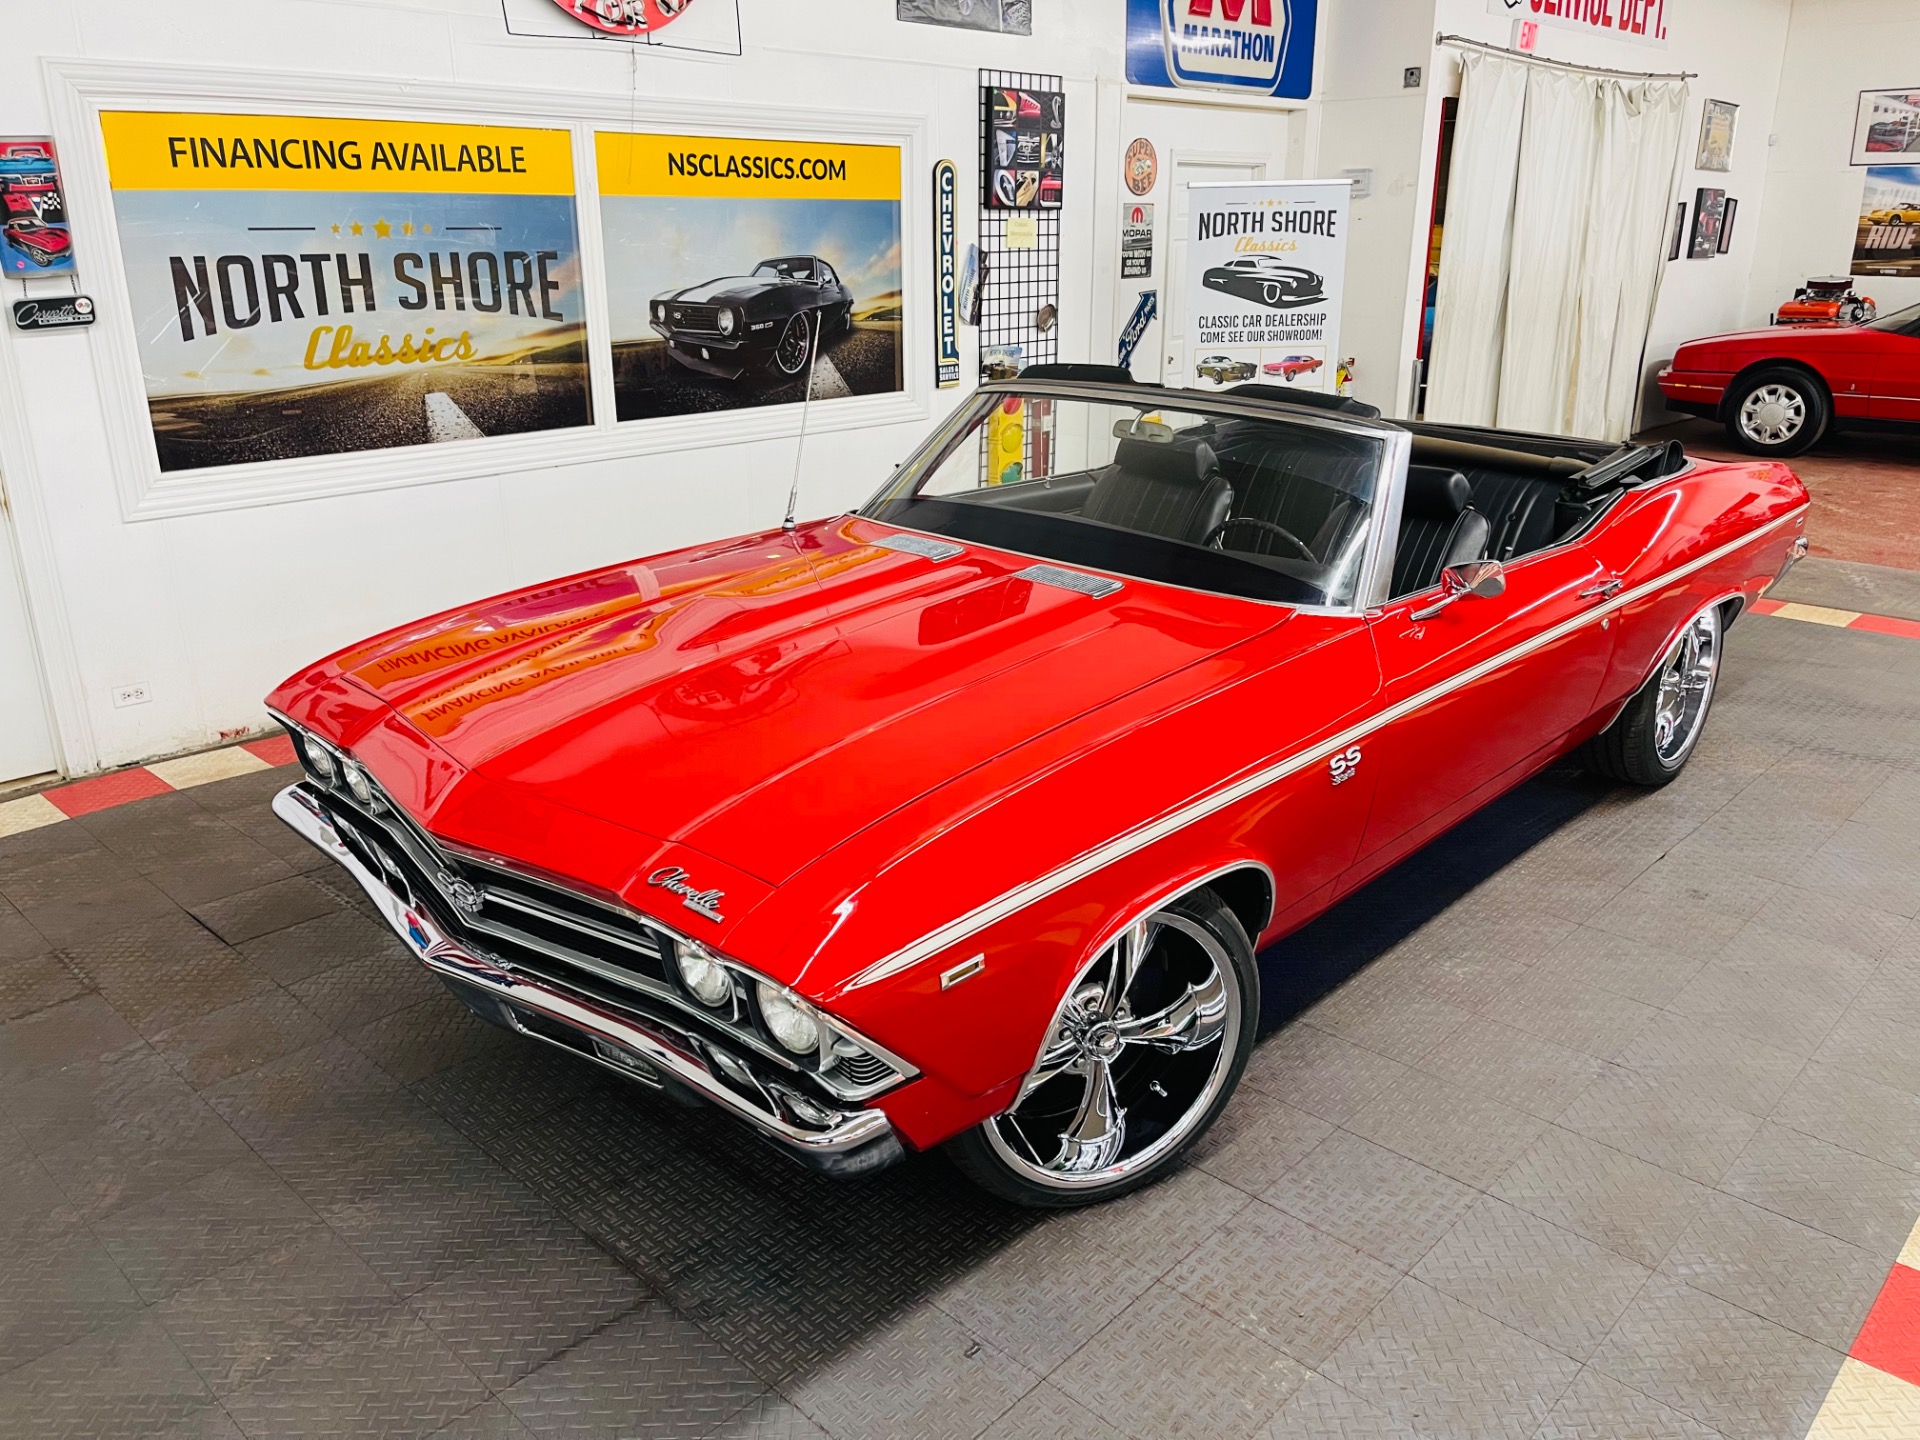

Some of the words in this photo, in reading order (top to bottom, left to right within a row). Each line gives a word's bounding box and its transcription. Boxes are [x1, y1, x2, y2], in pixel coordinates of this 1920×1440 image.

[1181, 23, 1275, 63] MARATHON
[167, 137, 362, 170] FINANCING
[371, 142, 527, 173] AVAILABLE
[668, 152, 846, 181] NSCLASSICS.COM
[1131, 172, 1153, 193] BEE
[1122, 229, 1152, 238] MOPAR
[1198, 211, 1265, 241] NORTH
[1271, 209, 1337, 238] SHORE
[1864, 226, 1918, 250] RIDE
[1234, 236, 1298, 253] Classics
[941, 172, 955, 354] CHEVROLET
[169, 252, 377, 342] NORTH
[393, 250, 564, 323] SHORE
[16, 303, 78, 326] Corvette
[1198, 315, 1239, 329] CLASSIC
[1242, 314, 1262, 328] CAR
[1265, 313, 1327, 327] DEALERSHIP
[1125, 310, 1147, 352] Ford
[1200, 331, 1226, 344] COME
[1228, 330, 1245, 343] SEE
[1246, 330, 1265, 342] OUR
[1267, 329, 1322, 342] SHOWROOM!
[304, 324, 478, 371] Classics
[939, 366, 954, 374] SALES
[939, 372, 959, 381] SERVICE
[1329, 745, 1362, 776] SS
[647, 865, 726, 910] Chevelle
